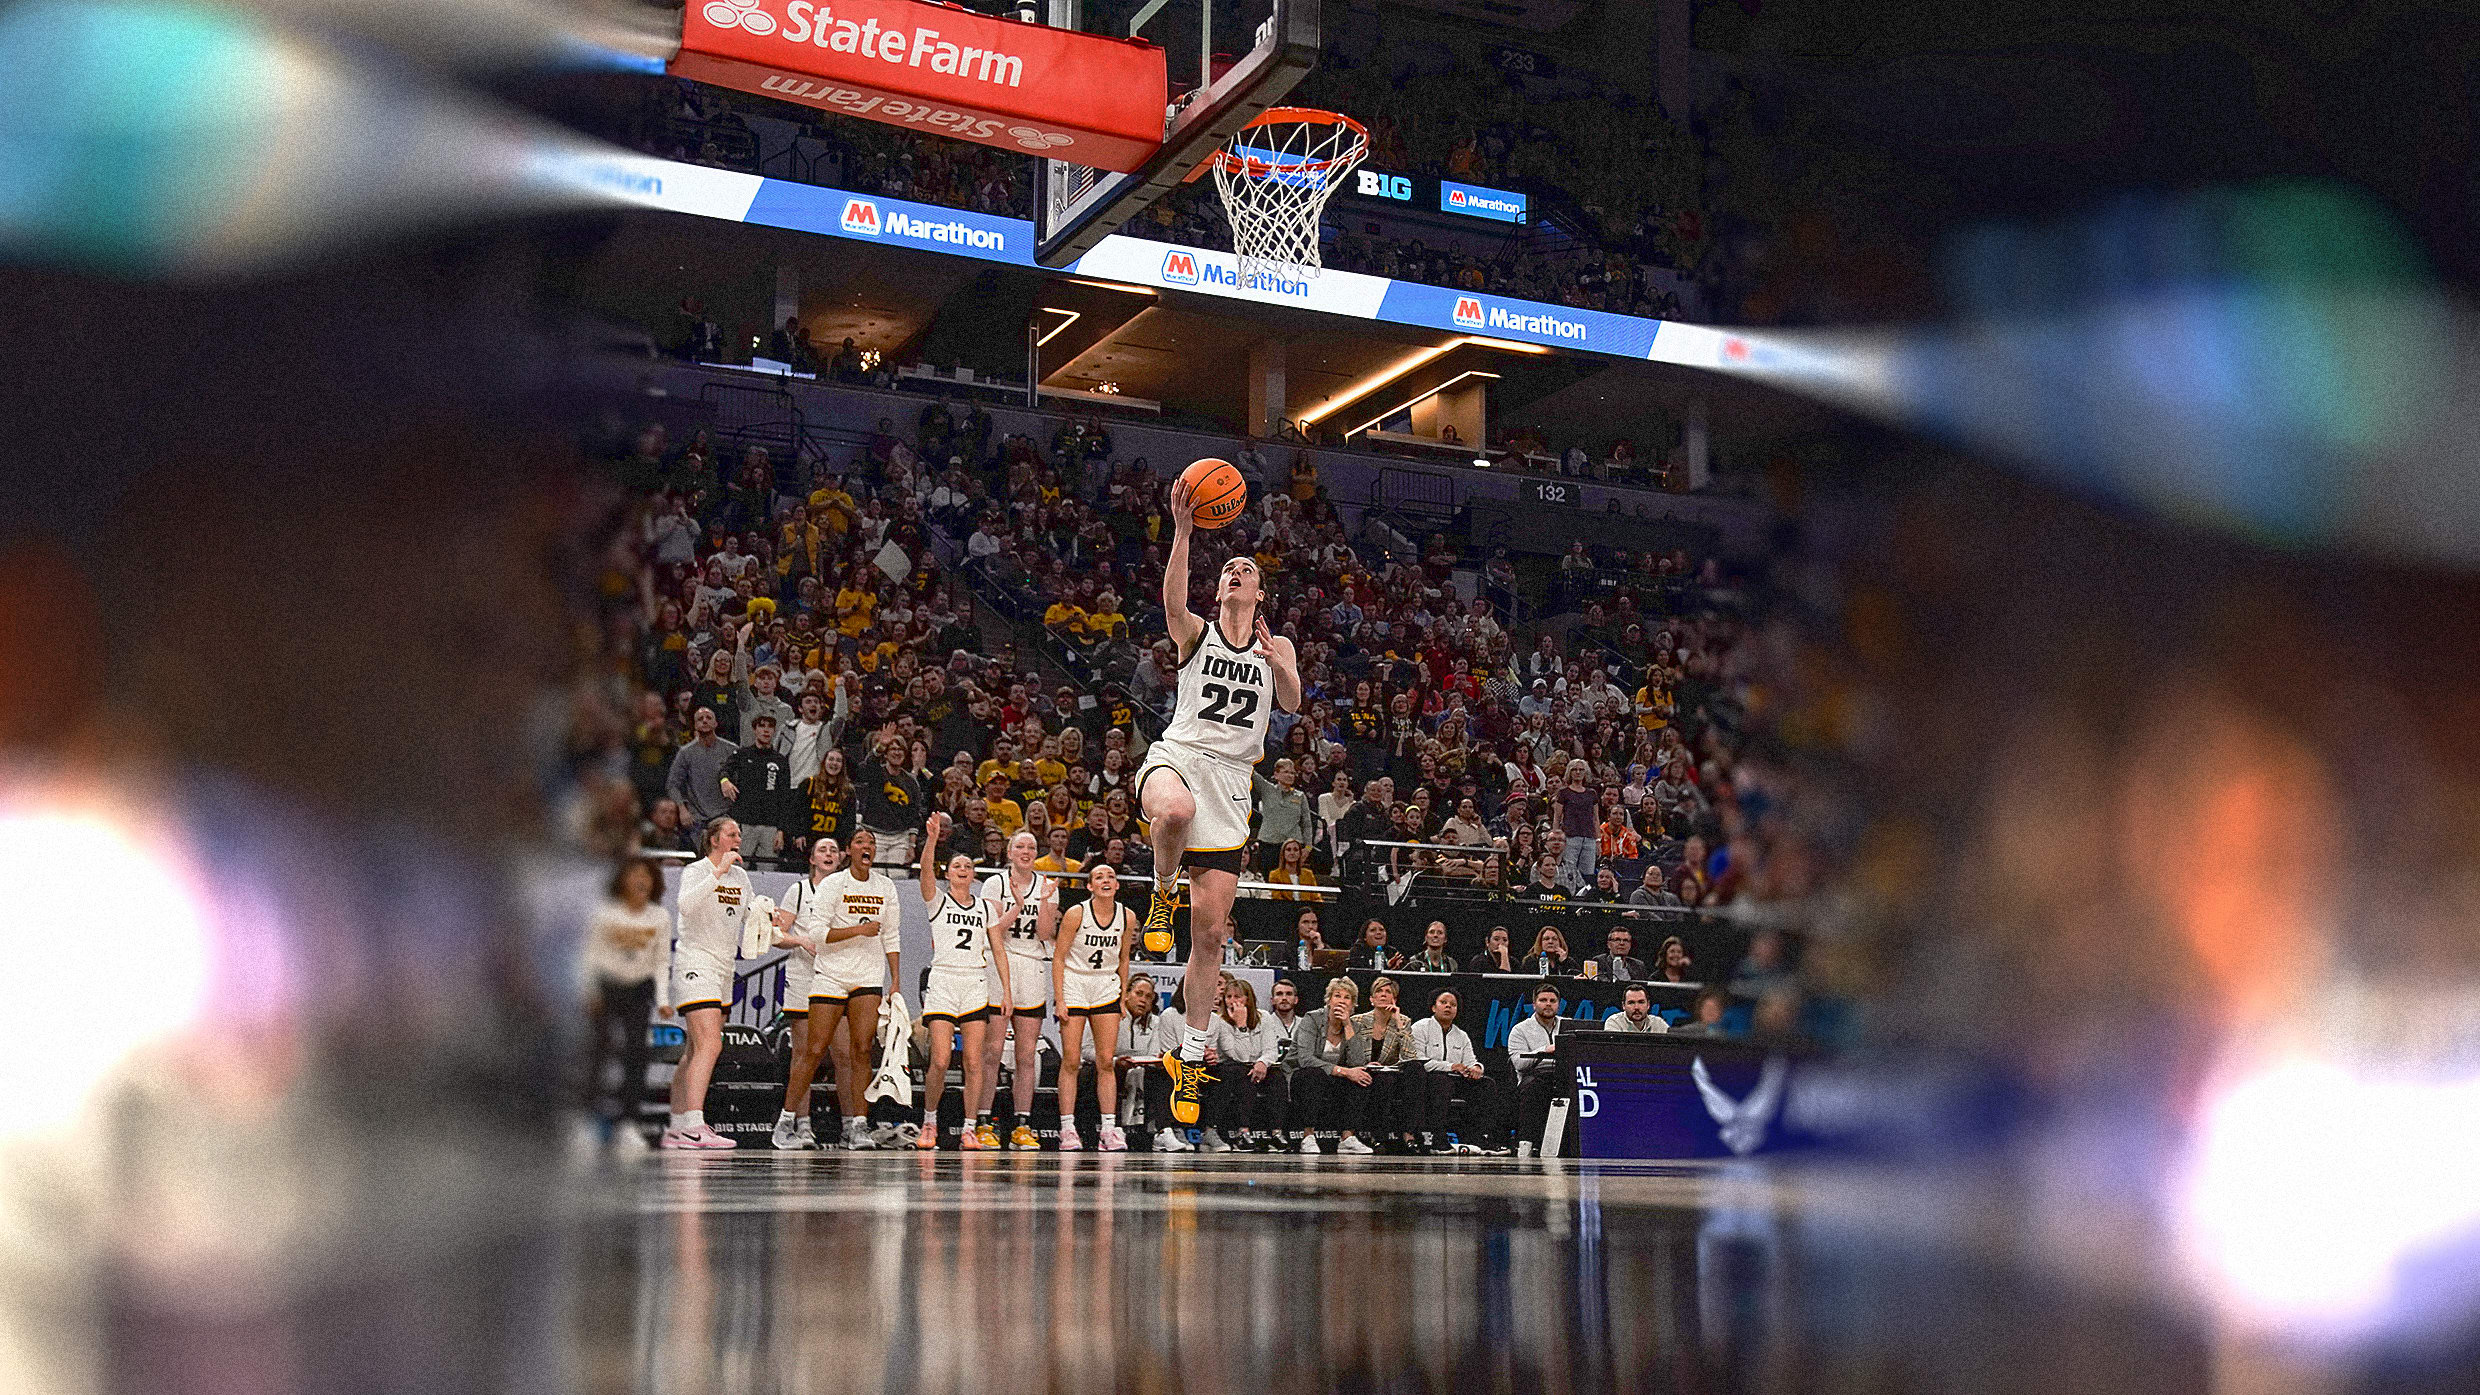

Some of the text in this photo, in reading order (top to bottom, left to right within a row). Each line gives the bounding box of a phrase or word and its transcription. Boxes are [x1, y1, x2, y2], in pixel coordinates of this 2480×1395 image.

[1468, 195, 1520, 214] Marathon
[884, 211, 1005, 250] Marathon
[1489, 307, 1586, 340] Marathon
[1536, 484, 1565, 502] 132
[1201, 655, 1264, 687] IOWA
[1198, 682, 1259, 729] 22
[811, 813, 837, 833] 20
[848, 905, 881, 916] ENERGY
[946, 912, 984, 929] IOWA
[1007, 918, 1039, 940] 44
[955, 928, 973, 951] 2
[1084, 933, 1118, 948] IOWA
[1088, 949, 1104, 970] 4
[727, 1032, 762, 1046] TIAA
